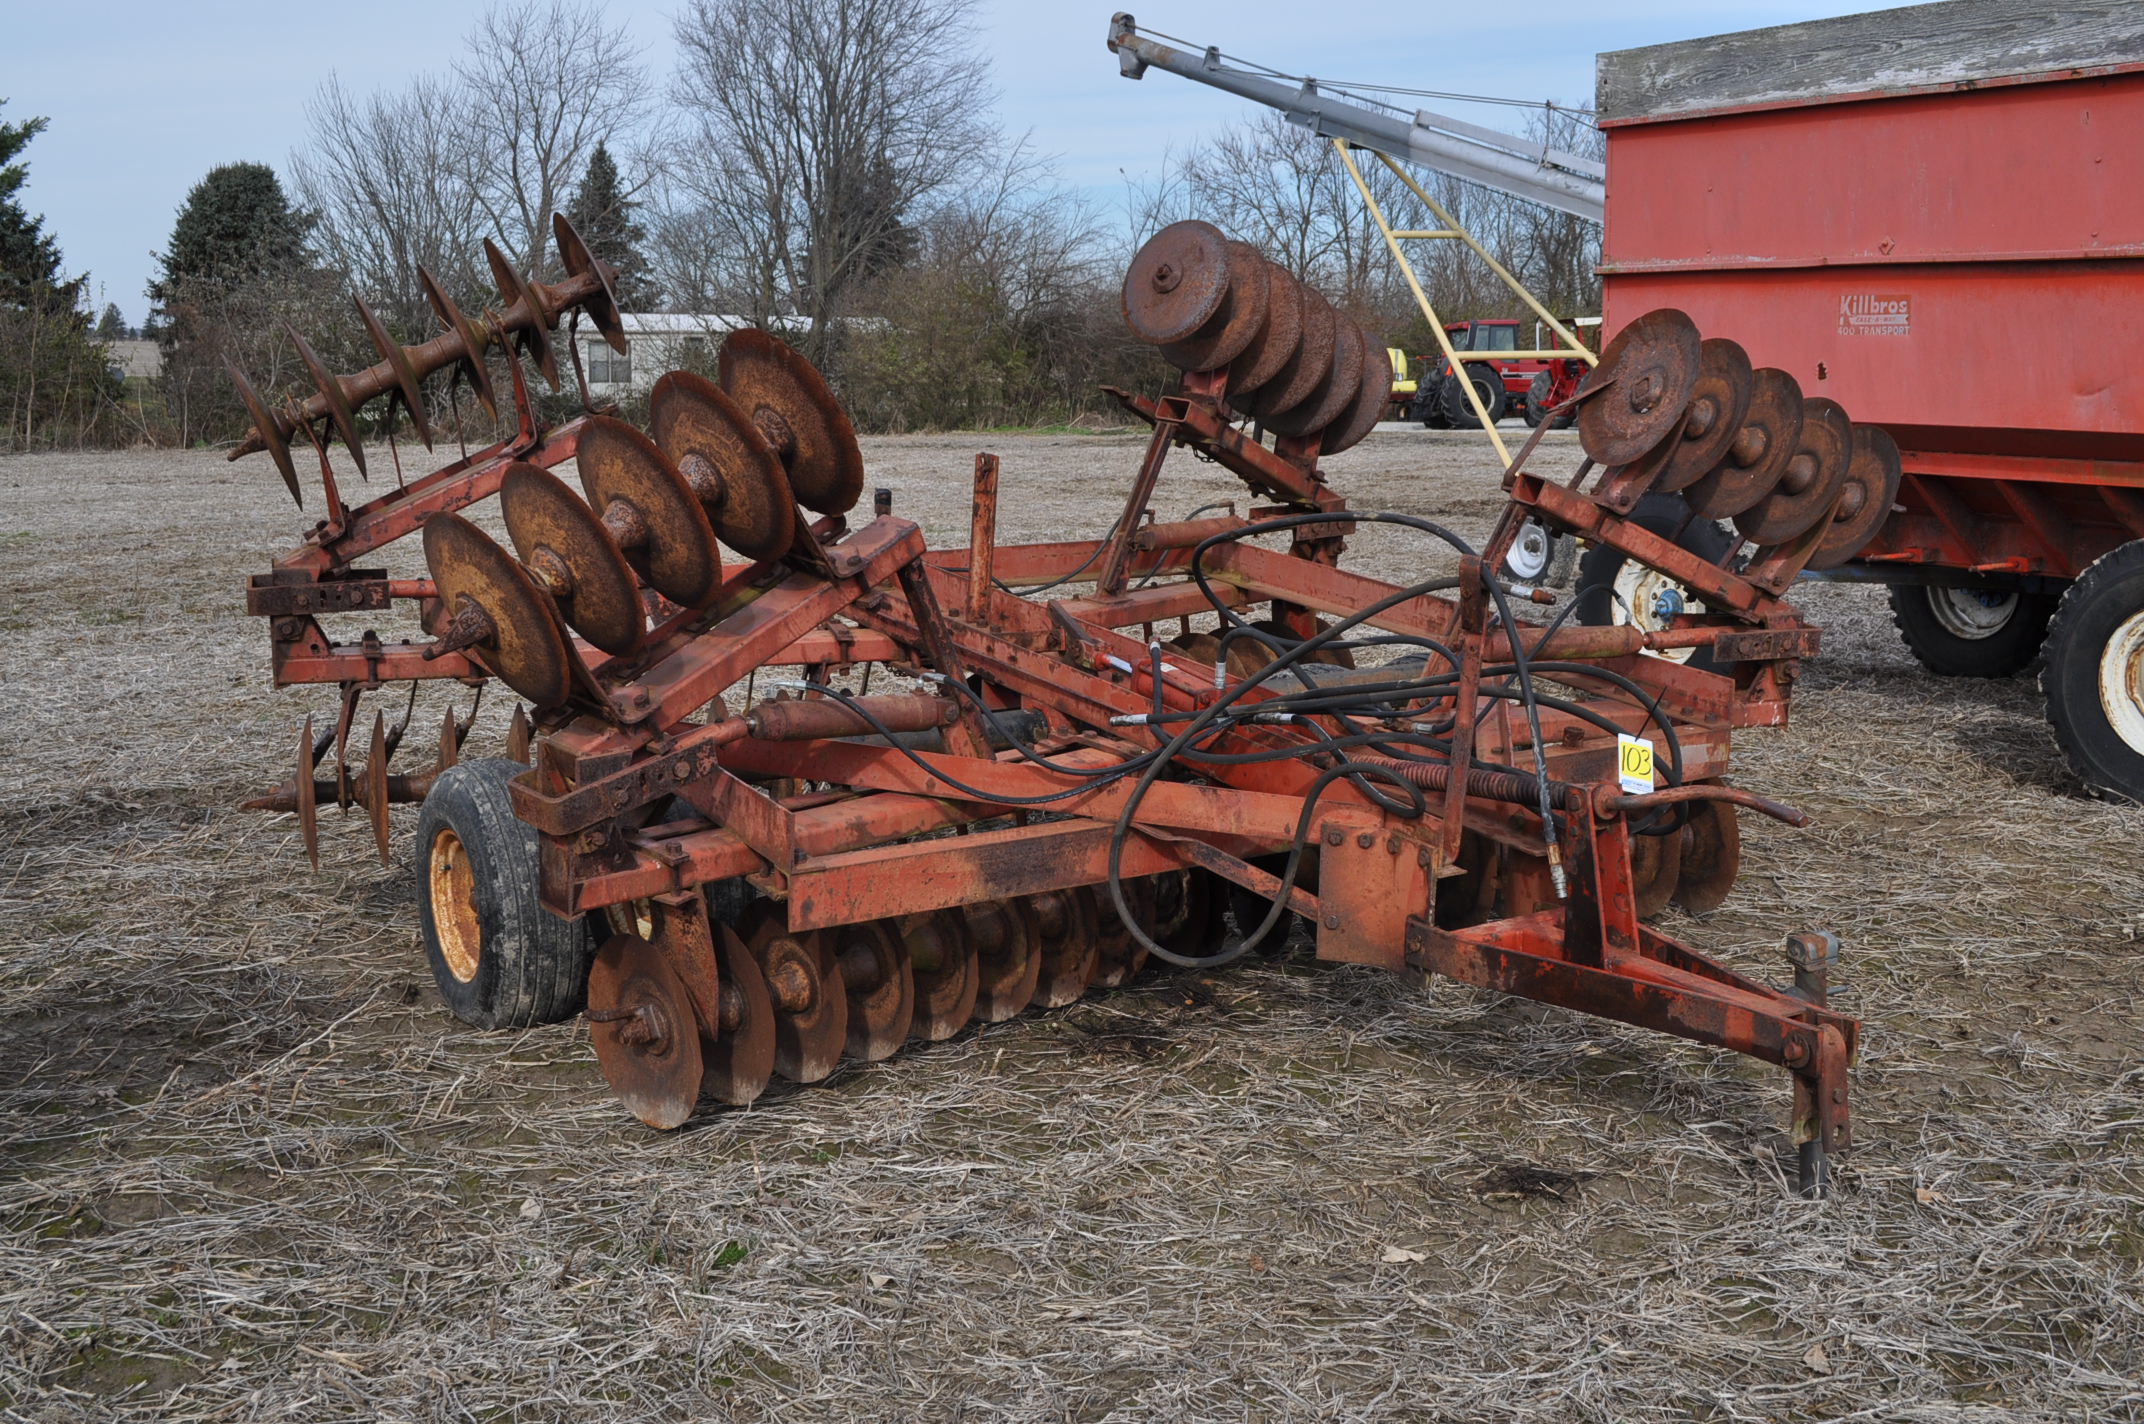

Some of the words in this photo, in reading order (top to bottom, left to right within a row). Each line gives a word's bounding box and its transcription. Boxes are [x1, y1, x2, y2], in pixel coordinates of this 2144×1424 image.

[1839, 295, 1908, 317] Killbros
[1859, 325, 1911, 337] TRANSPORT
[1621, 745, 1652, 776] 103
